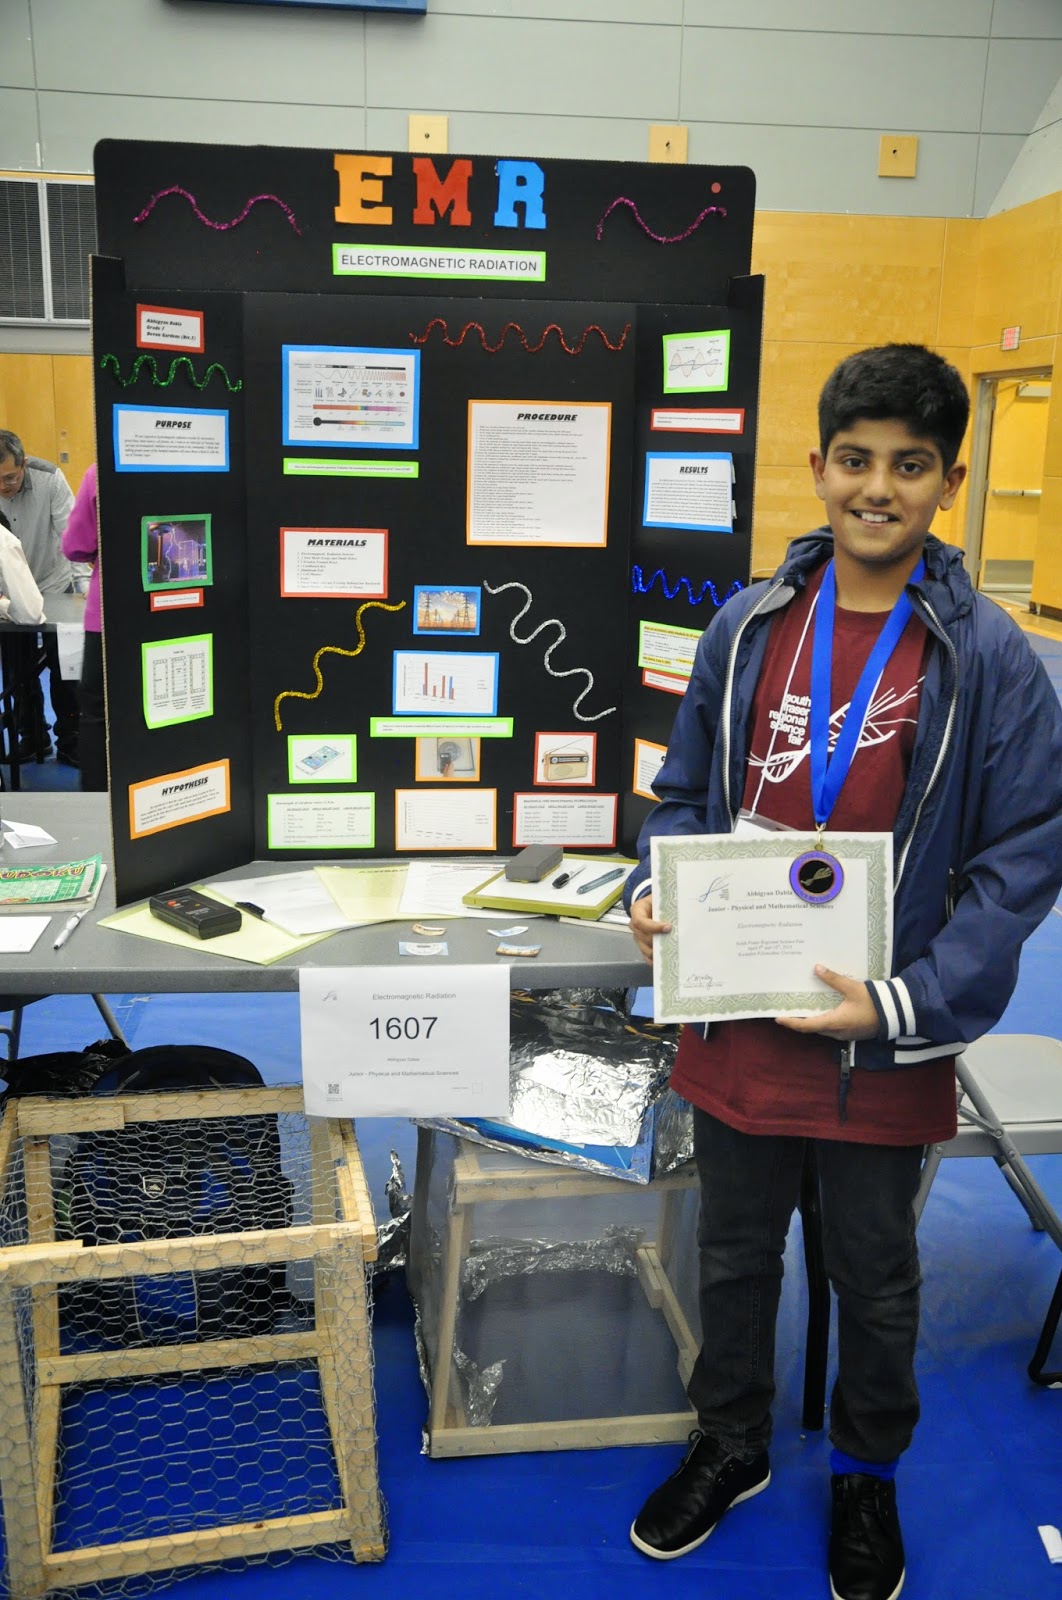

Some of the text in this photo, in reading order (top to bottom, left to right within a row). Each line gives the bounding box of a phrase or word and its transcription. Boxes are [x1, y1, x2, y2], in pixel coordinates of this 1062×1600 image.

[341, 254, 537, 271] ELECTROMAGNETIC RADIATION
[516, 413, 578, 421] PROCEDURE
[155, 420, 192, 429] PURPOSE
[679, 466, 709, 474] RESULTS
[307, 538, 367, 546] MATERIALS
[786, 694, 811, 707] south
[788, 733, 804, 746] fair
[161, 776, 209, 796] HYPOTHESIS
[0, 863, 86, 879] UDOKU
[746, 890, 774, 898] Abhigyan
[369, 1016, 438, 1040] 1607
